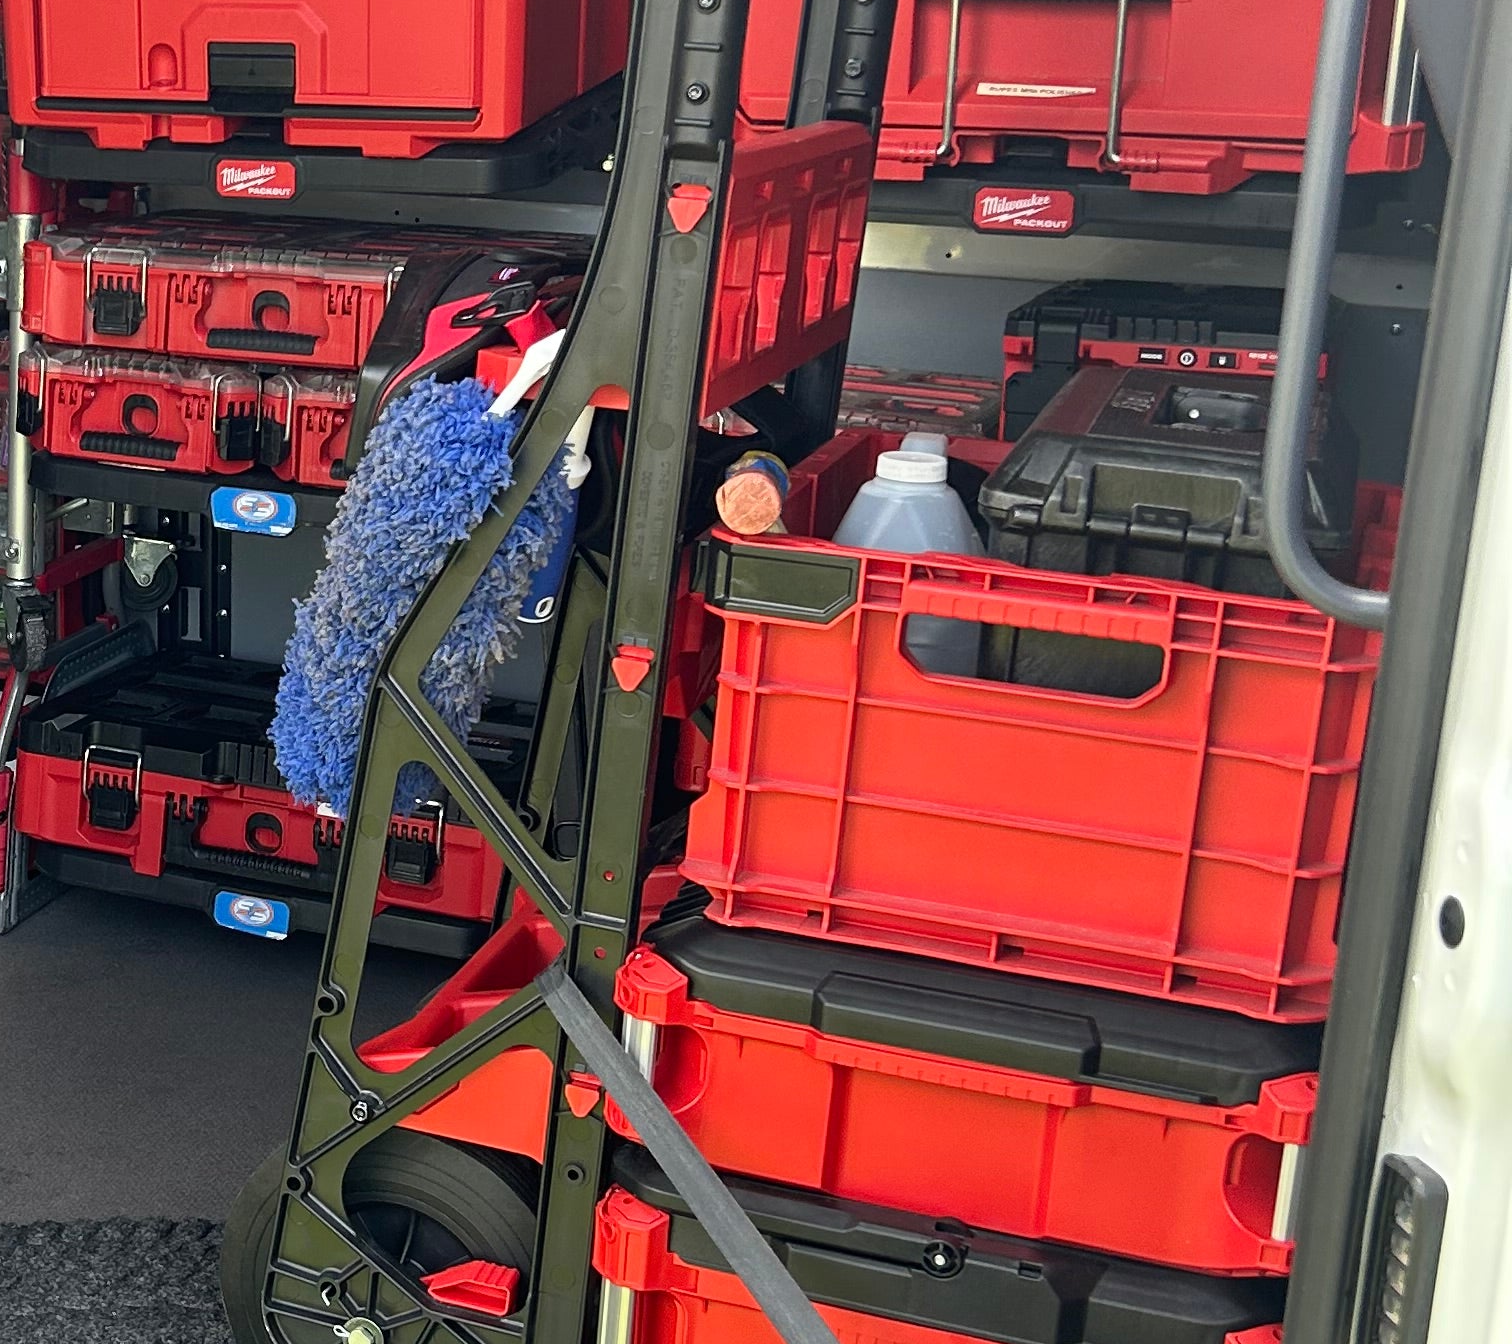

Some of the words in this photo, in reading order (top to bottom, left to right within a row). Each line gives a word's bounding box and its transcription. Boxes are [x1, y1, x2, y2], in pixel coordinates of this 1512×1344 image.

[220, 163, 277, 187] Milwaukee
[248, 187, 292, 196] PACKOUT
[980, 193, 1052, 217] Milwaukee
[1013, 218, 1068, 229] PACKOUT
